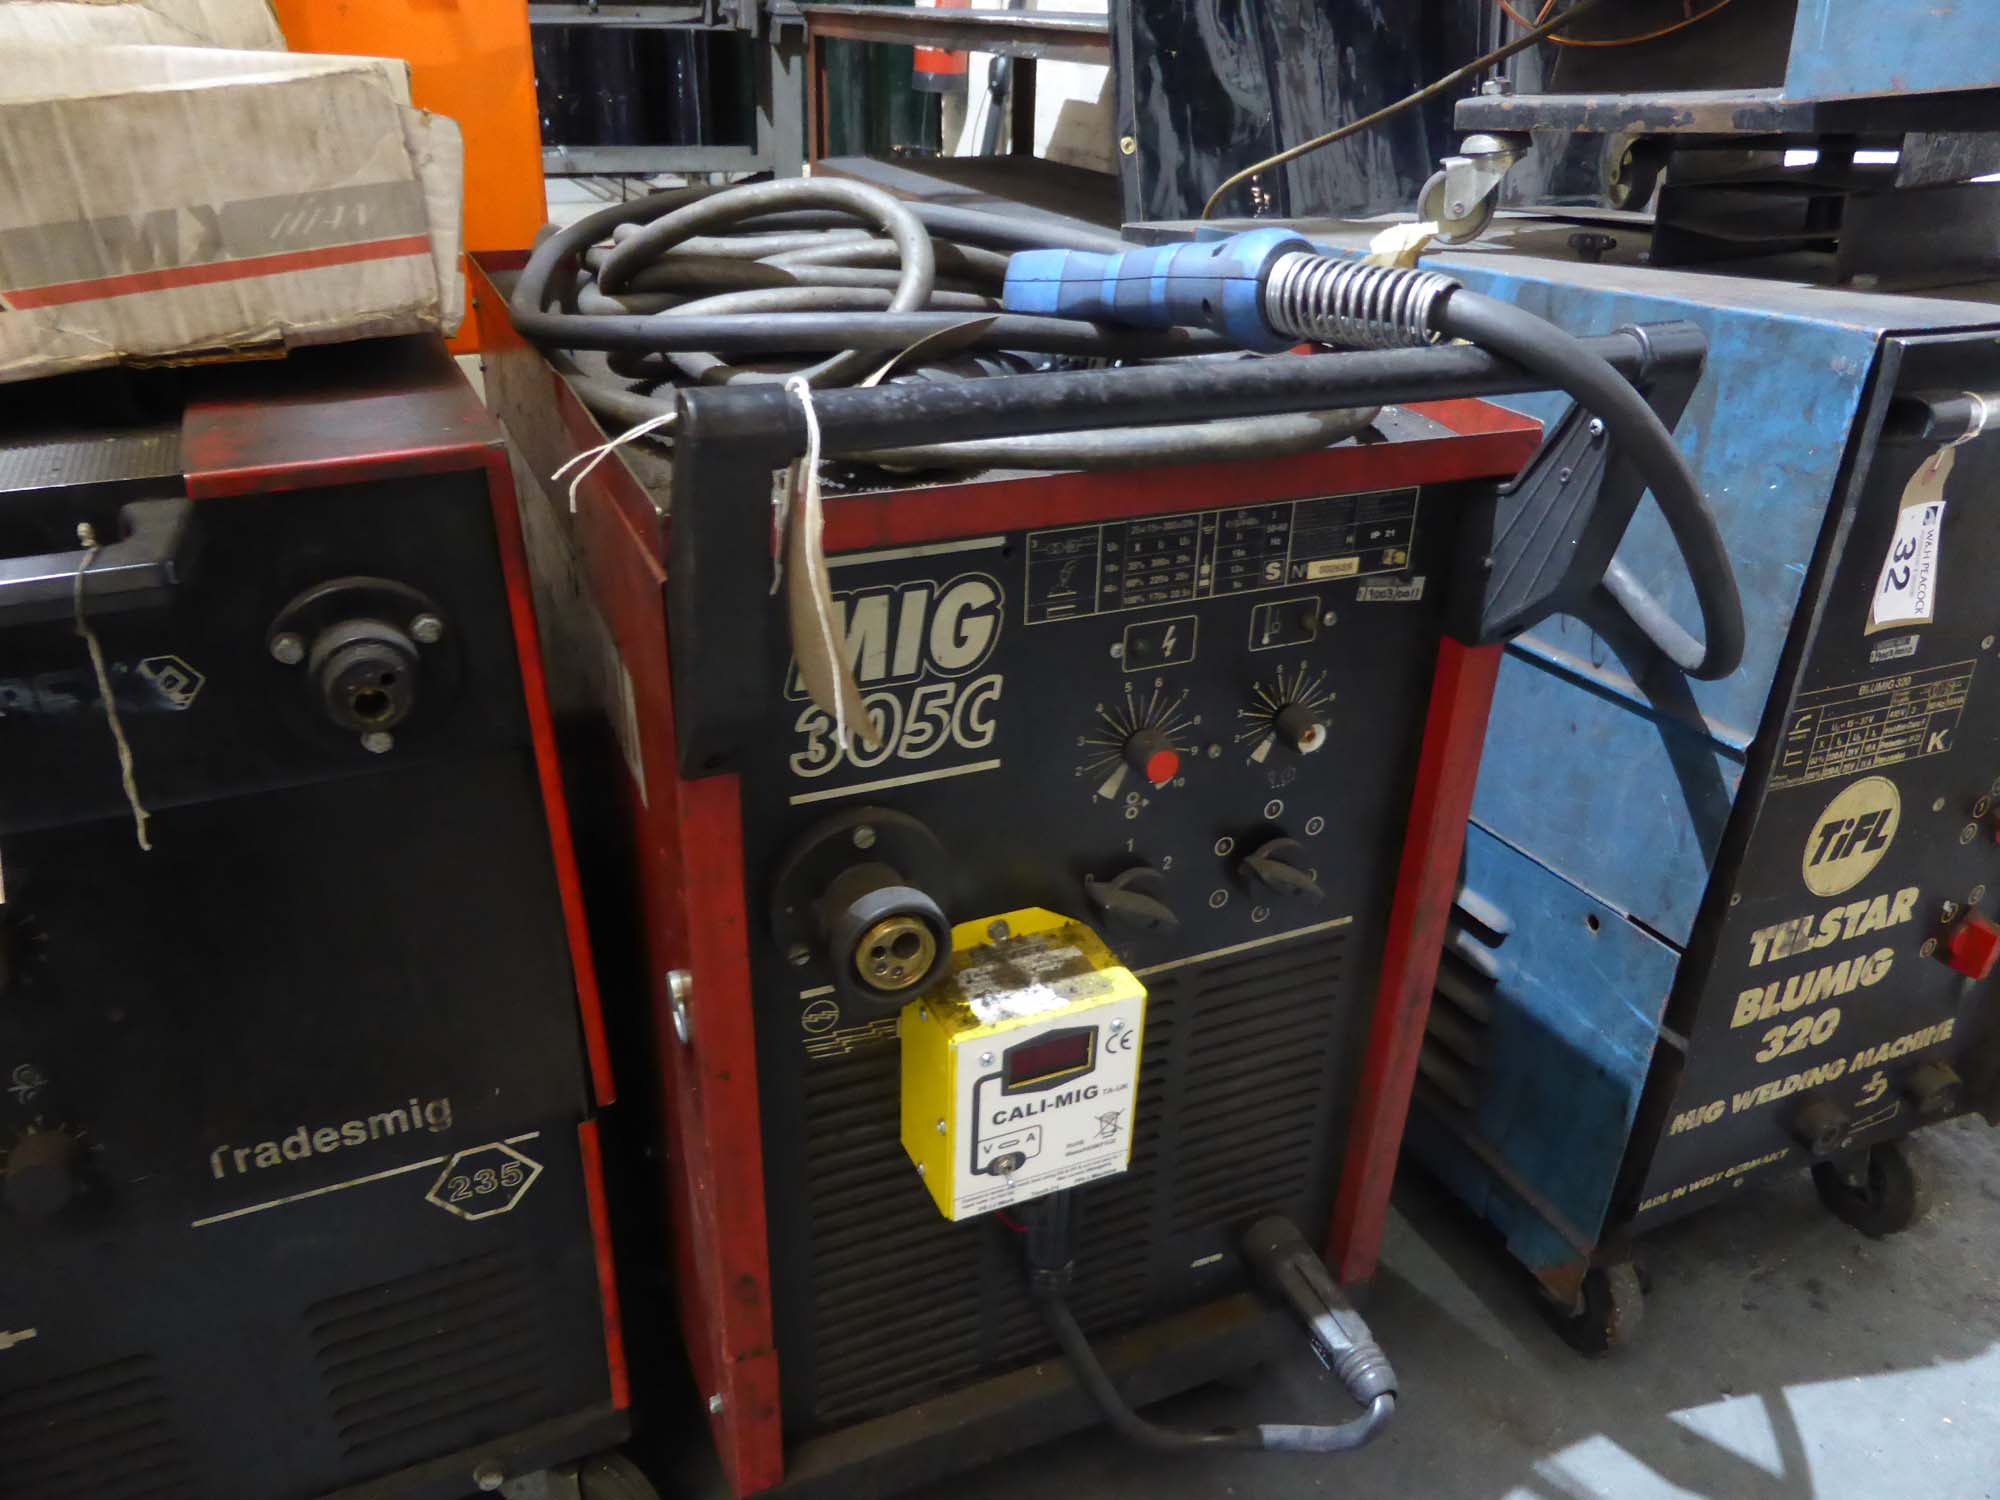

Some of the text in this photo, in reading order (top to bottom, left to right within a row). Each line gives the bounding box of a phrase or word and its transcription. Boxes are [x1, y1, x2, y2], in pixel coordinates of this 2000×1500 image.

[1265, 562, 1281, 581] S
[1884, 537, 1917, 594] 32
[1914, 562, 1930, 615] PEACOCK
[792, 576, 1002, 694] MIG
[790, 674, 1004, 778] 305C
[1927, 729, 1949, 753] K
[1163, 856, 1172, 871] 2
[1747, 886, 1920, 967] TELSTAR
[1730, 948, 1894, 1029] BLUMIG
[1756, 1007, 1841, 1063] 320
[1667, 1018, 1957, 1136] MIG WELDING MACHINE
[992, 1085, 1099, 1126] CALI-MIG
[209, 1098, 453, 1180] Tradesmig
[984, 1144, 993, 1154] V
[1026, 1132, 1036, 1143] A
[448, 1160, 525, 1202] 235
